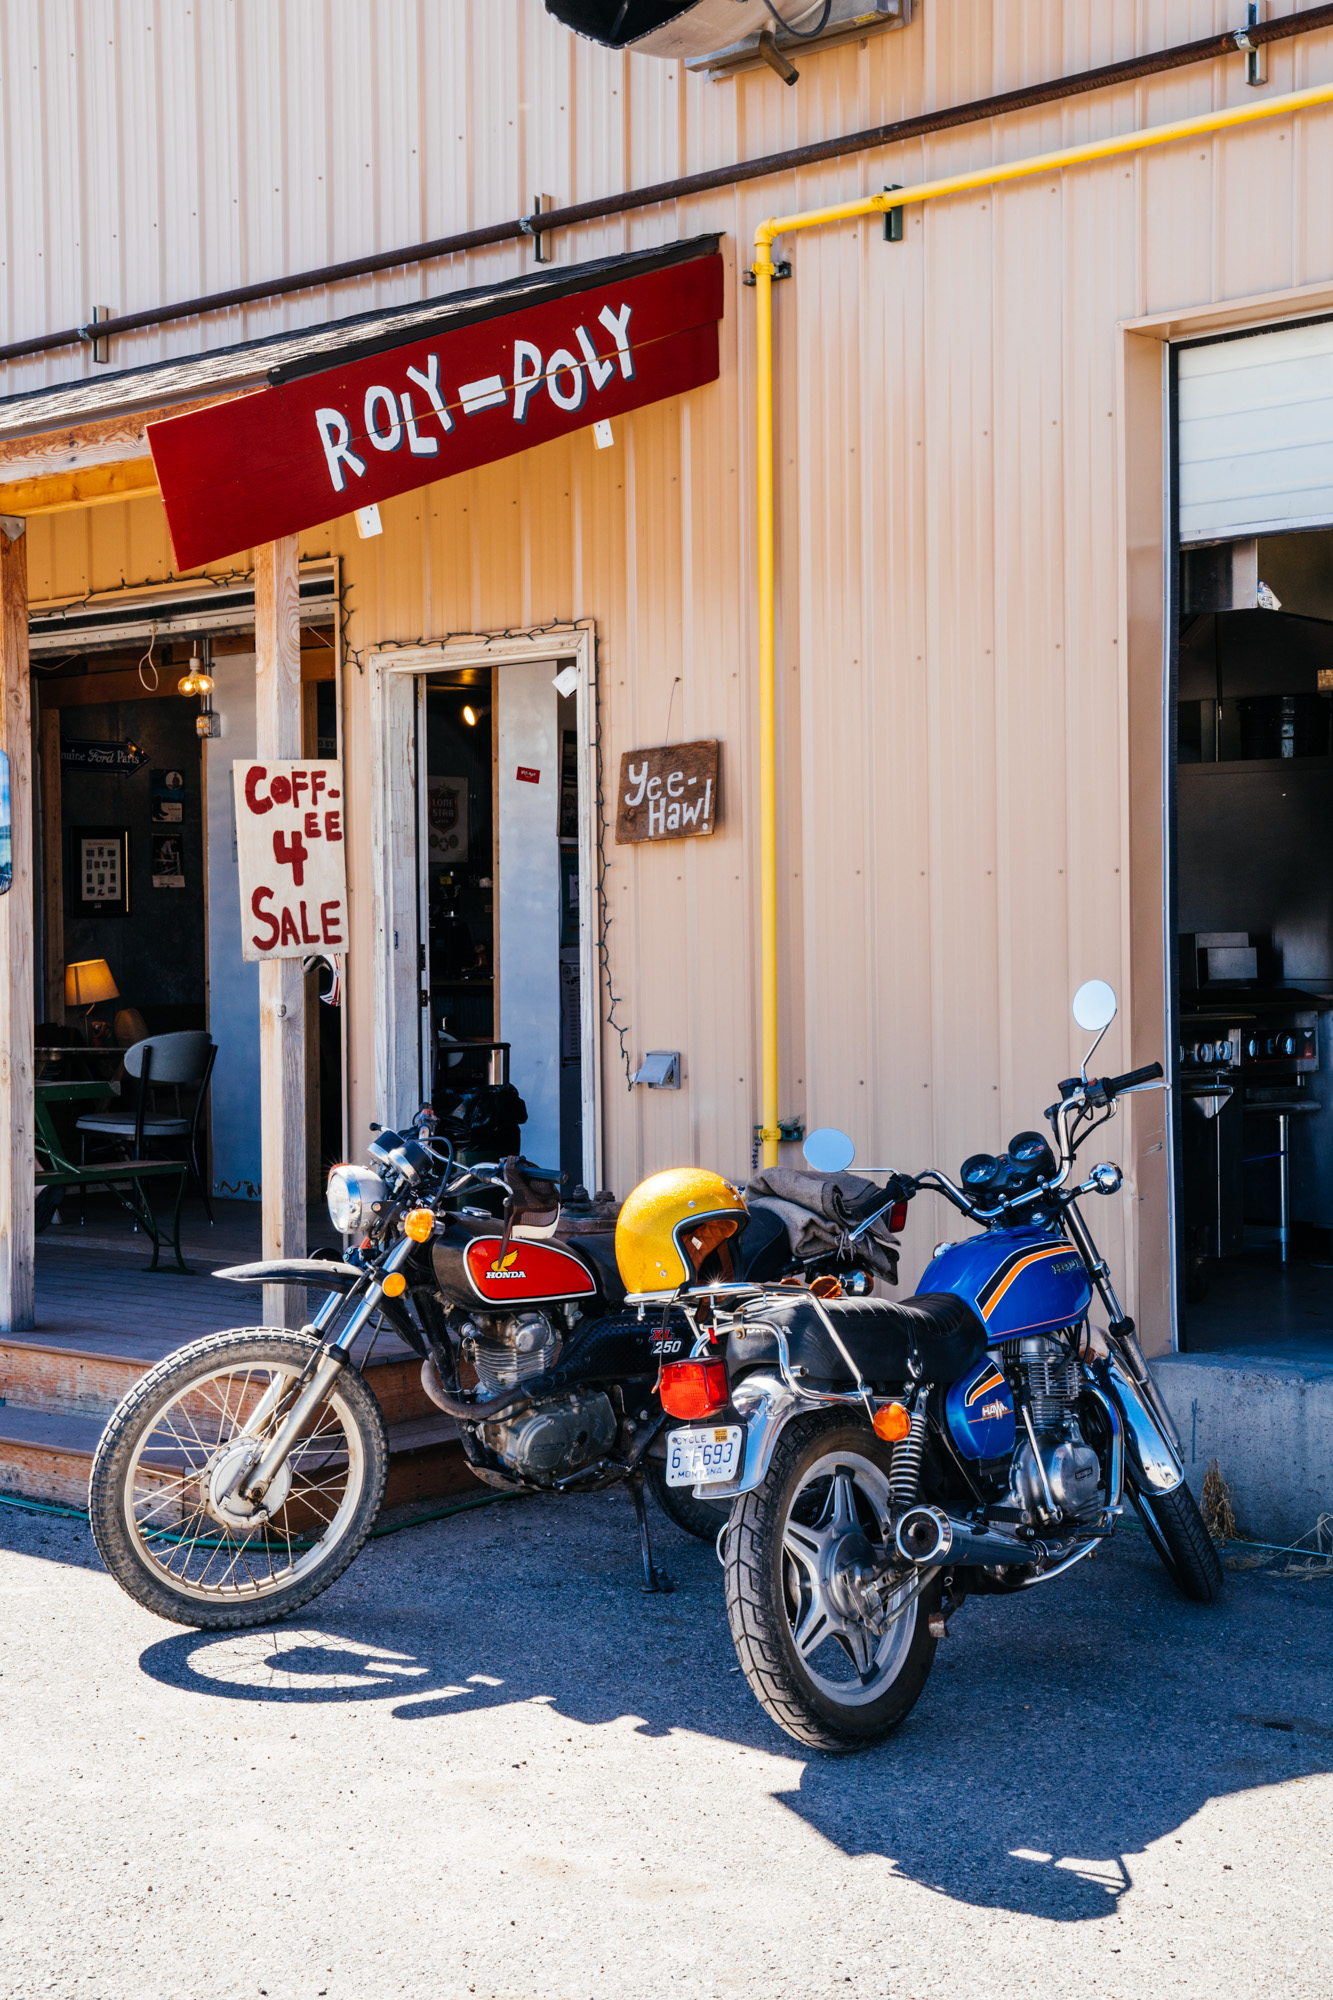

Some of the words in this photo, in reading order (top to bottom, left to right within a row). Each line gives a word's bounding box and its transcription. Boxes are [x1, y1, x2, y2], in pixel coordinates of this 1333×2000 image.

[60, 749, 86, 761] nuine
[87, 748, 115, 763] Ford
[117, 750, 140, 764] Parts
[244, 766, 341, 815] COFF-
[624, 761, 697, 807] Yee-
[647, 778, 712, 837] Haw!
[304, 811, 343, 841] EE
[272, 830, 308, 887] 4
[251, 886, 343, 951] SALE
[485, 1270, 527, 1279] HONDA
[650, 1328, 674, 1341] XL
[652, 1340, 682, 1354] 250
[676, 1434, 707, 1445] CYCLE
